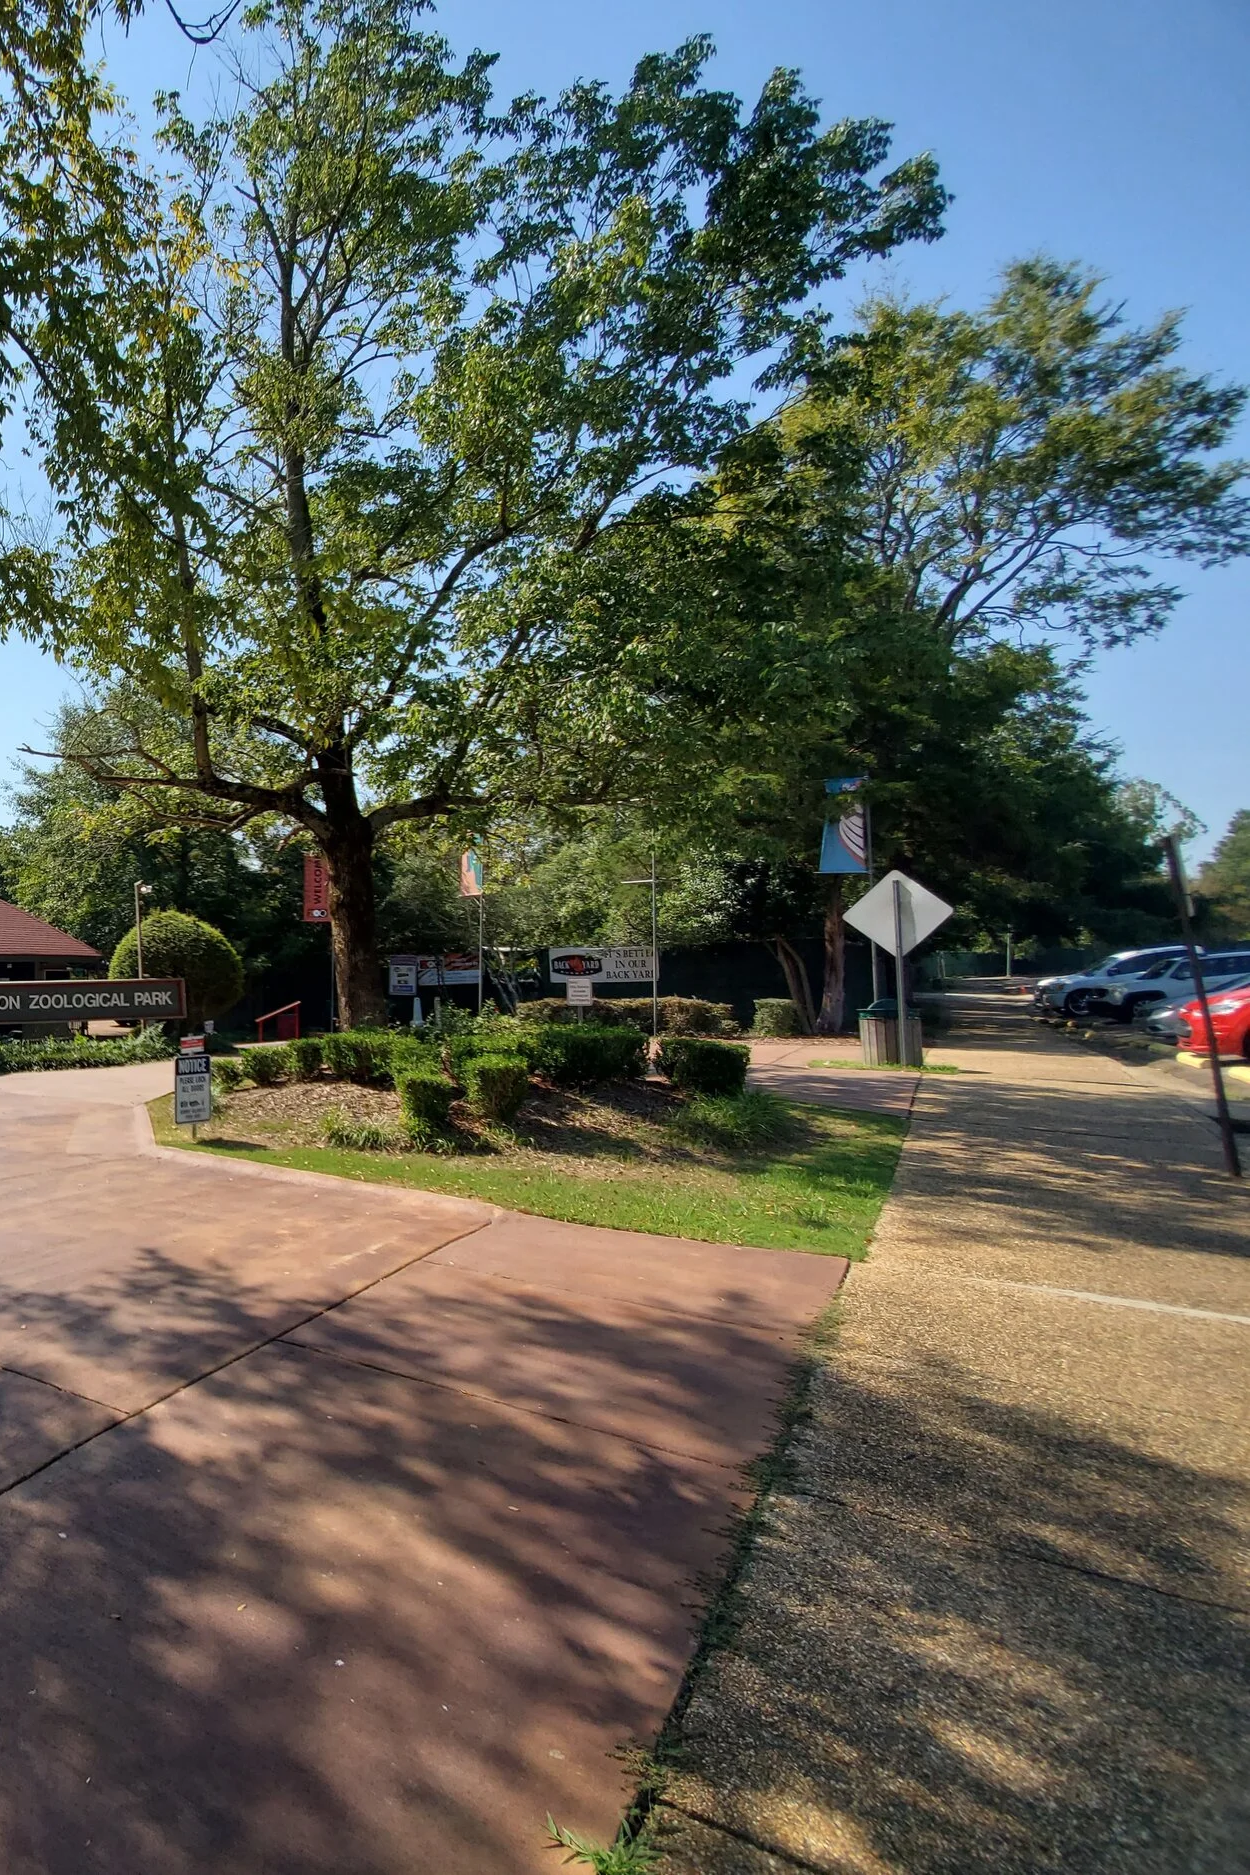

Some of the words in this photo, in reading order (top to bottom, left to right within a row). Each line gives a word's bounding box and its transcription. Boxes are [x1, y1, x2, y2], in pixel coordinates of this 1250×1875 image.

[623, 949, 654, 958] BETTE
[554, 961, 570, 970] BACK
[582, 960, 601, 970] YARD
[615, 960, 626, 969] IN
[628, 960, 647, 968] OUR
[606, 970, 630, 980] BACK
[632, 970, 654, 979] YAR
[28, 993, 130, 1010] ZOOLOGICAL
[134, 991, 174, 1007] PARK
[178, 1058, 207, 1074] NOTICE
